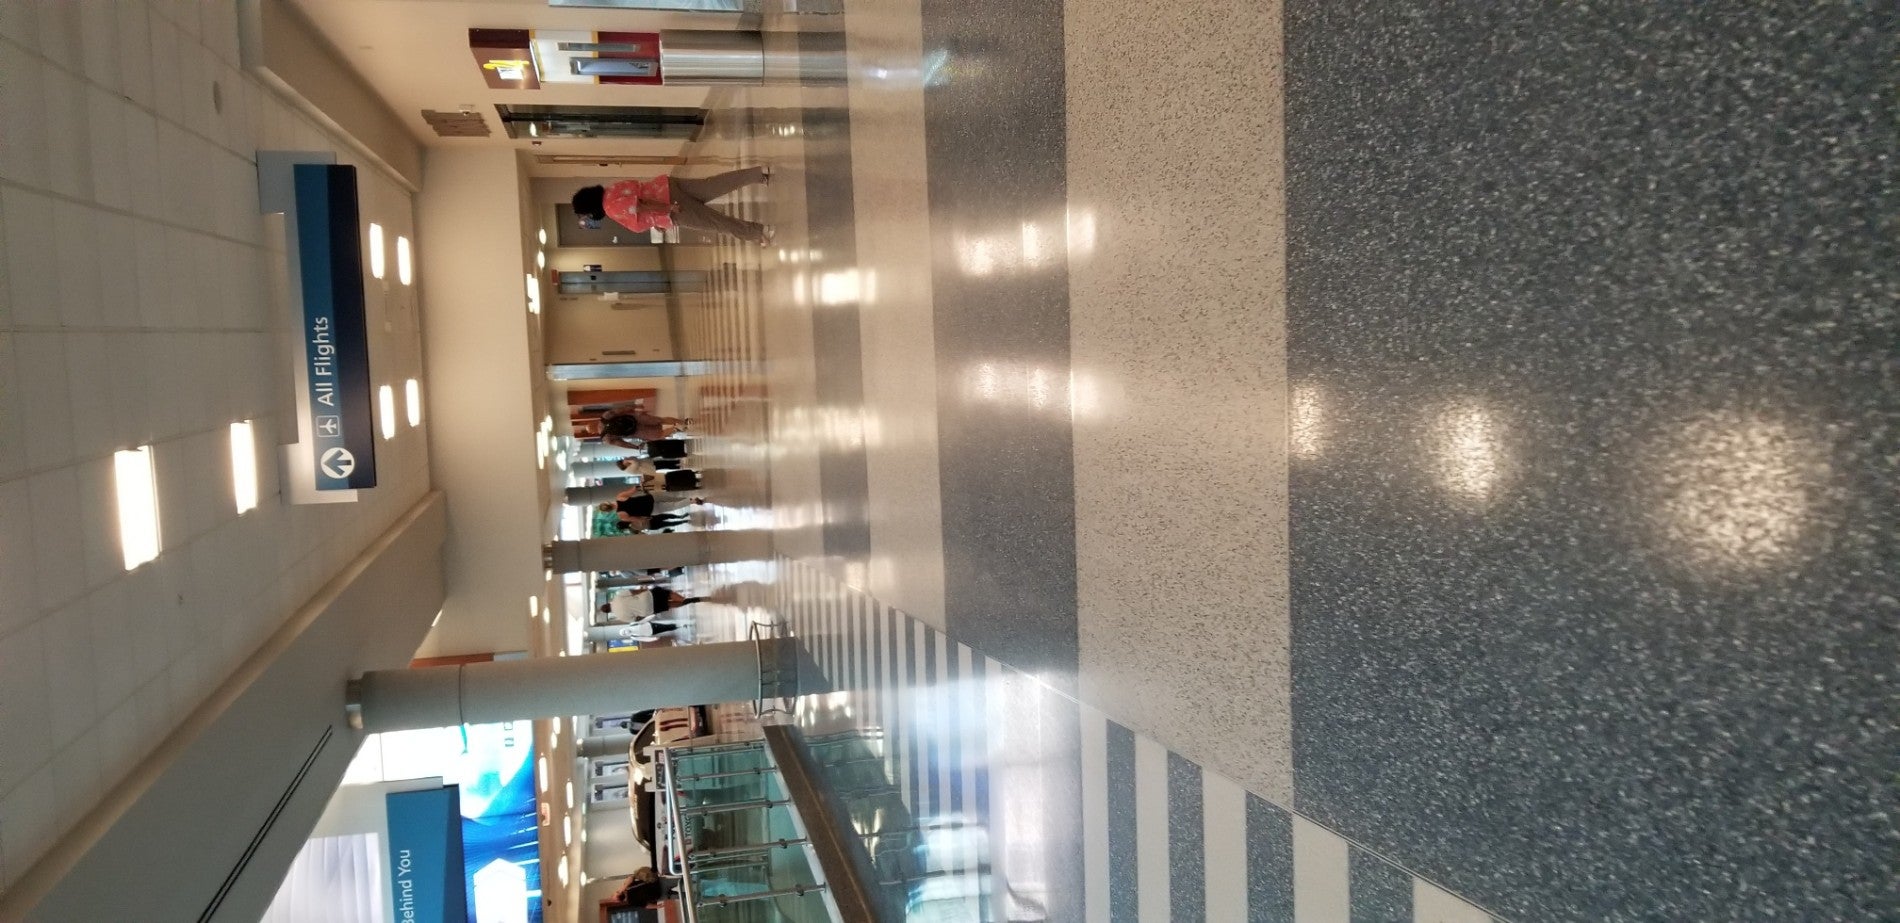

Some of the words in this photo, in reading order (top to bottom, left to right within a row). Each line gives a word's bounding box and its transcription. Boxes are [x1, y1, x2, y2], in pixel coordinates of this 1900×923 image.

[312, 316, 335, 376] Flights
[315, 382, 334, 407] All
[397, 849, 411, 877] You
